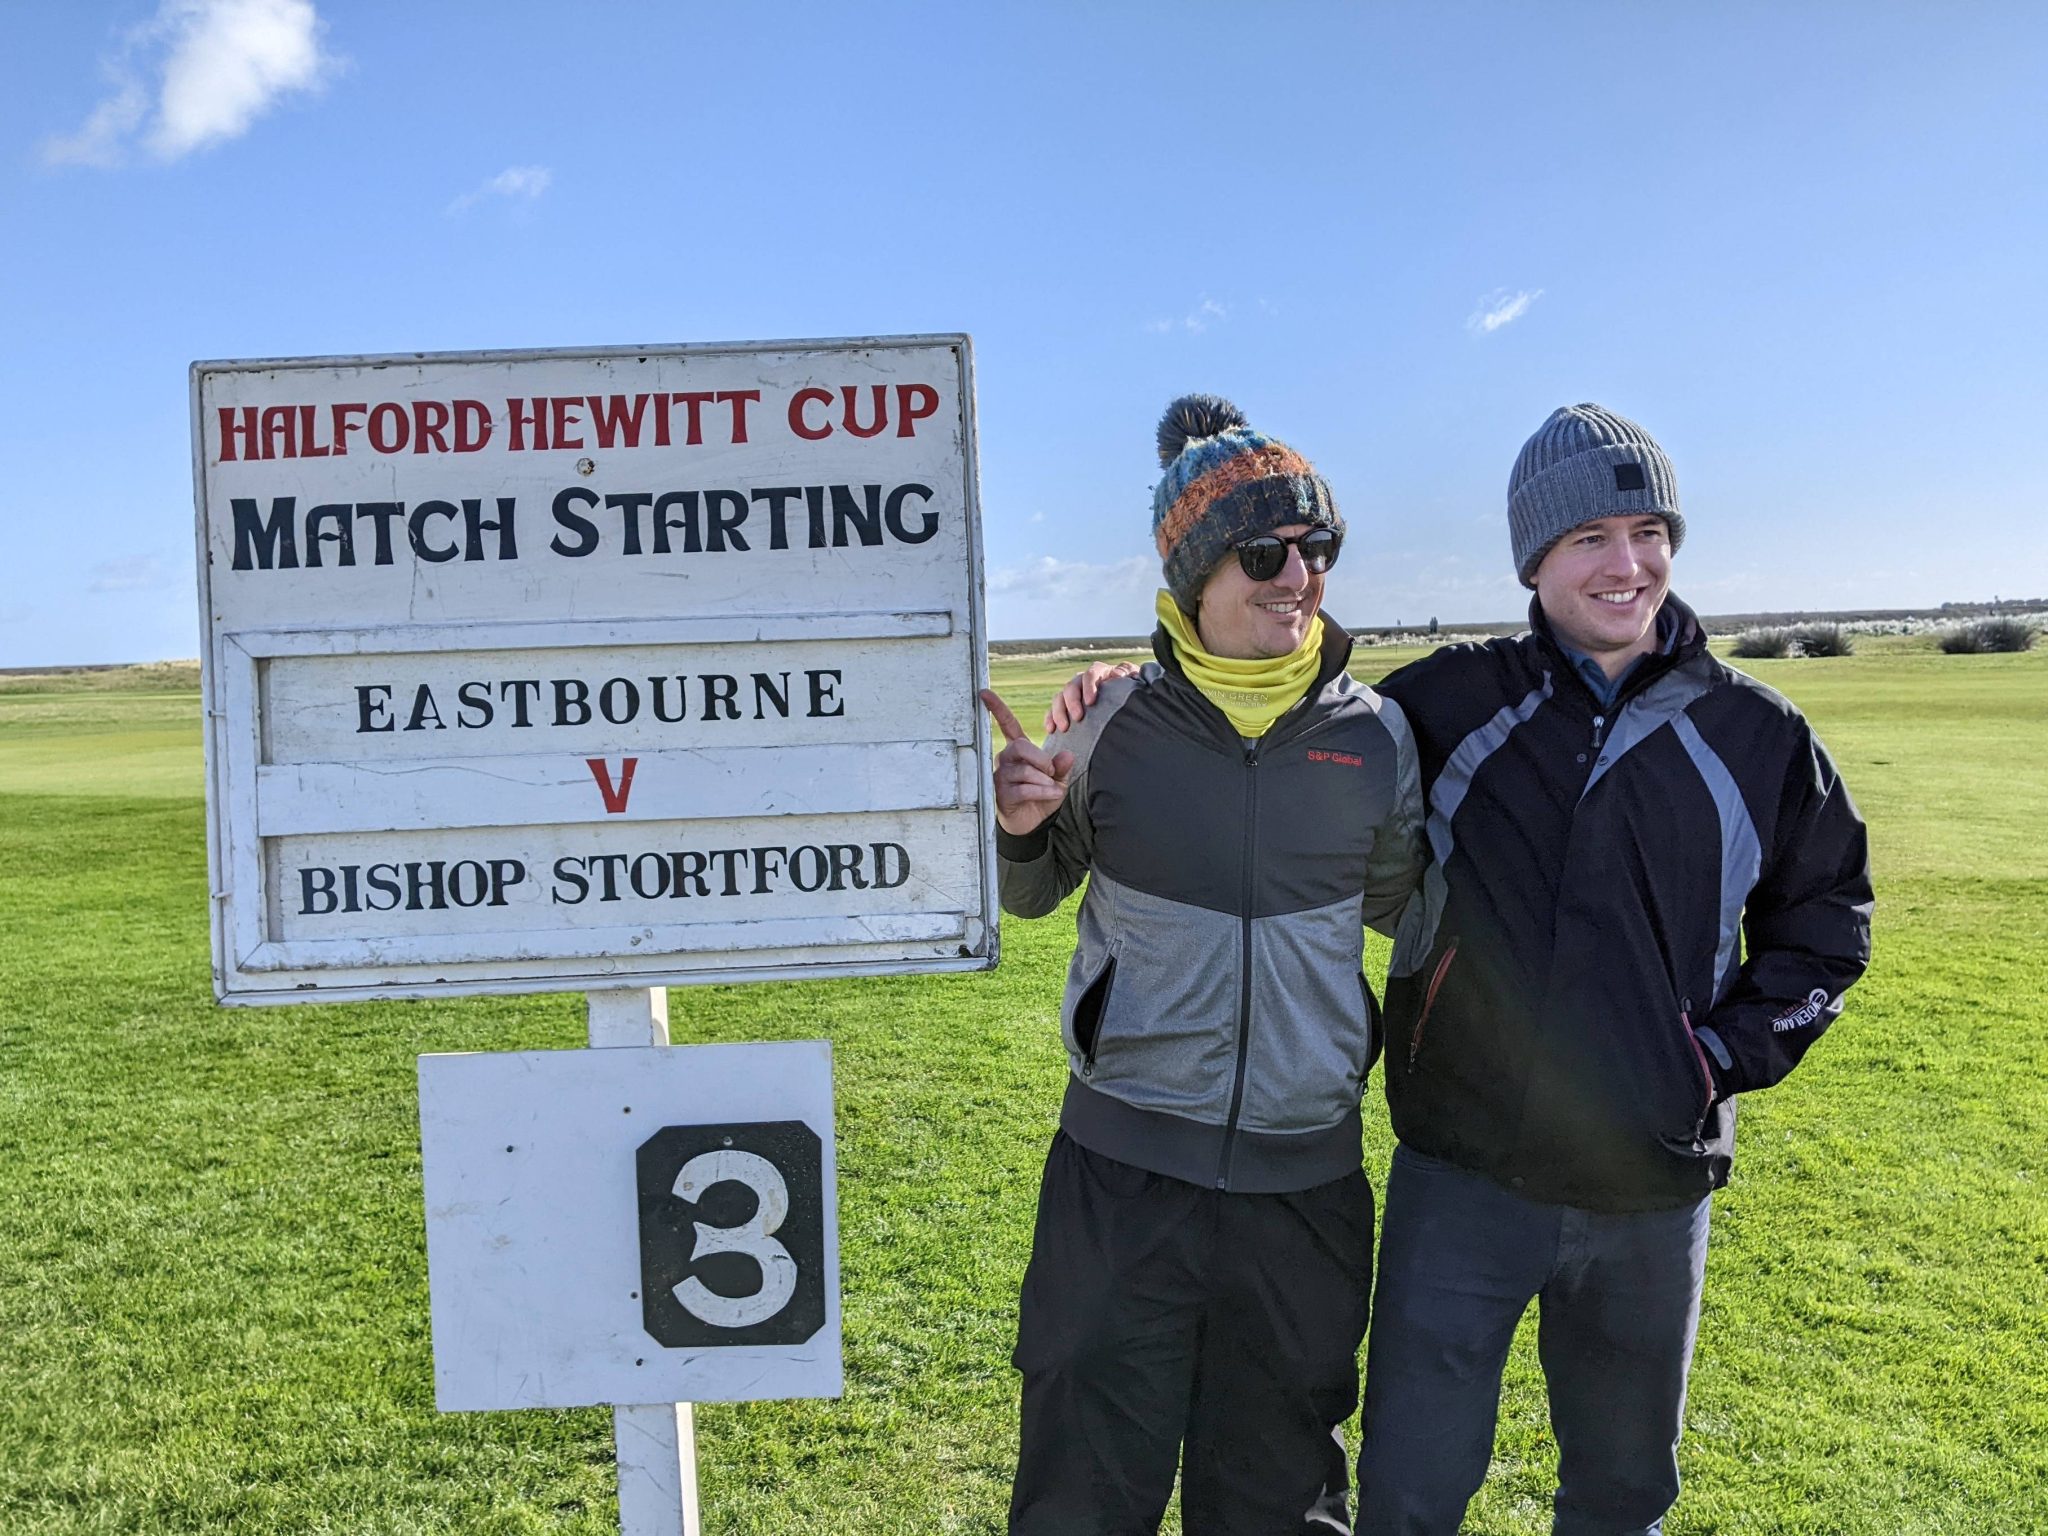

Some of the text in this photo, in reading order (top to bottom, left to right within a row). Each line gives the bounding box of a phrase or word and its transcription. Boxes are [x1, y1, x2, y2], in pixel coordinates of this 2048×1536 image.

[218, 382, 941, 462] HALFORD HEWITT CUP
[230, 483, 940, 571] MATCH STARTING
[354, 669, 846, 734] EASTBOURNE
[586, 757, 639, 815] V
[1308, 750, 1362, 766] S&P Global
[297, 841, 911, 917] BISHOP STORTFORD
[672, 1149, 798, 1328] 3
